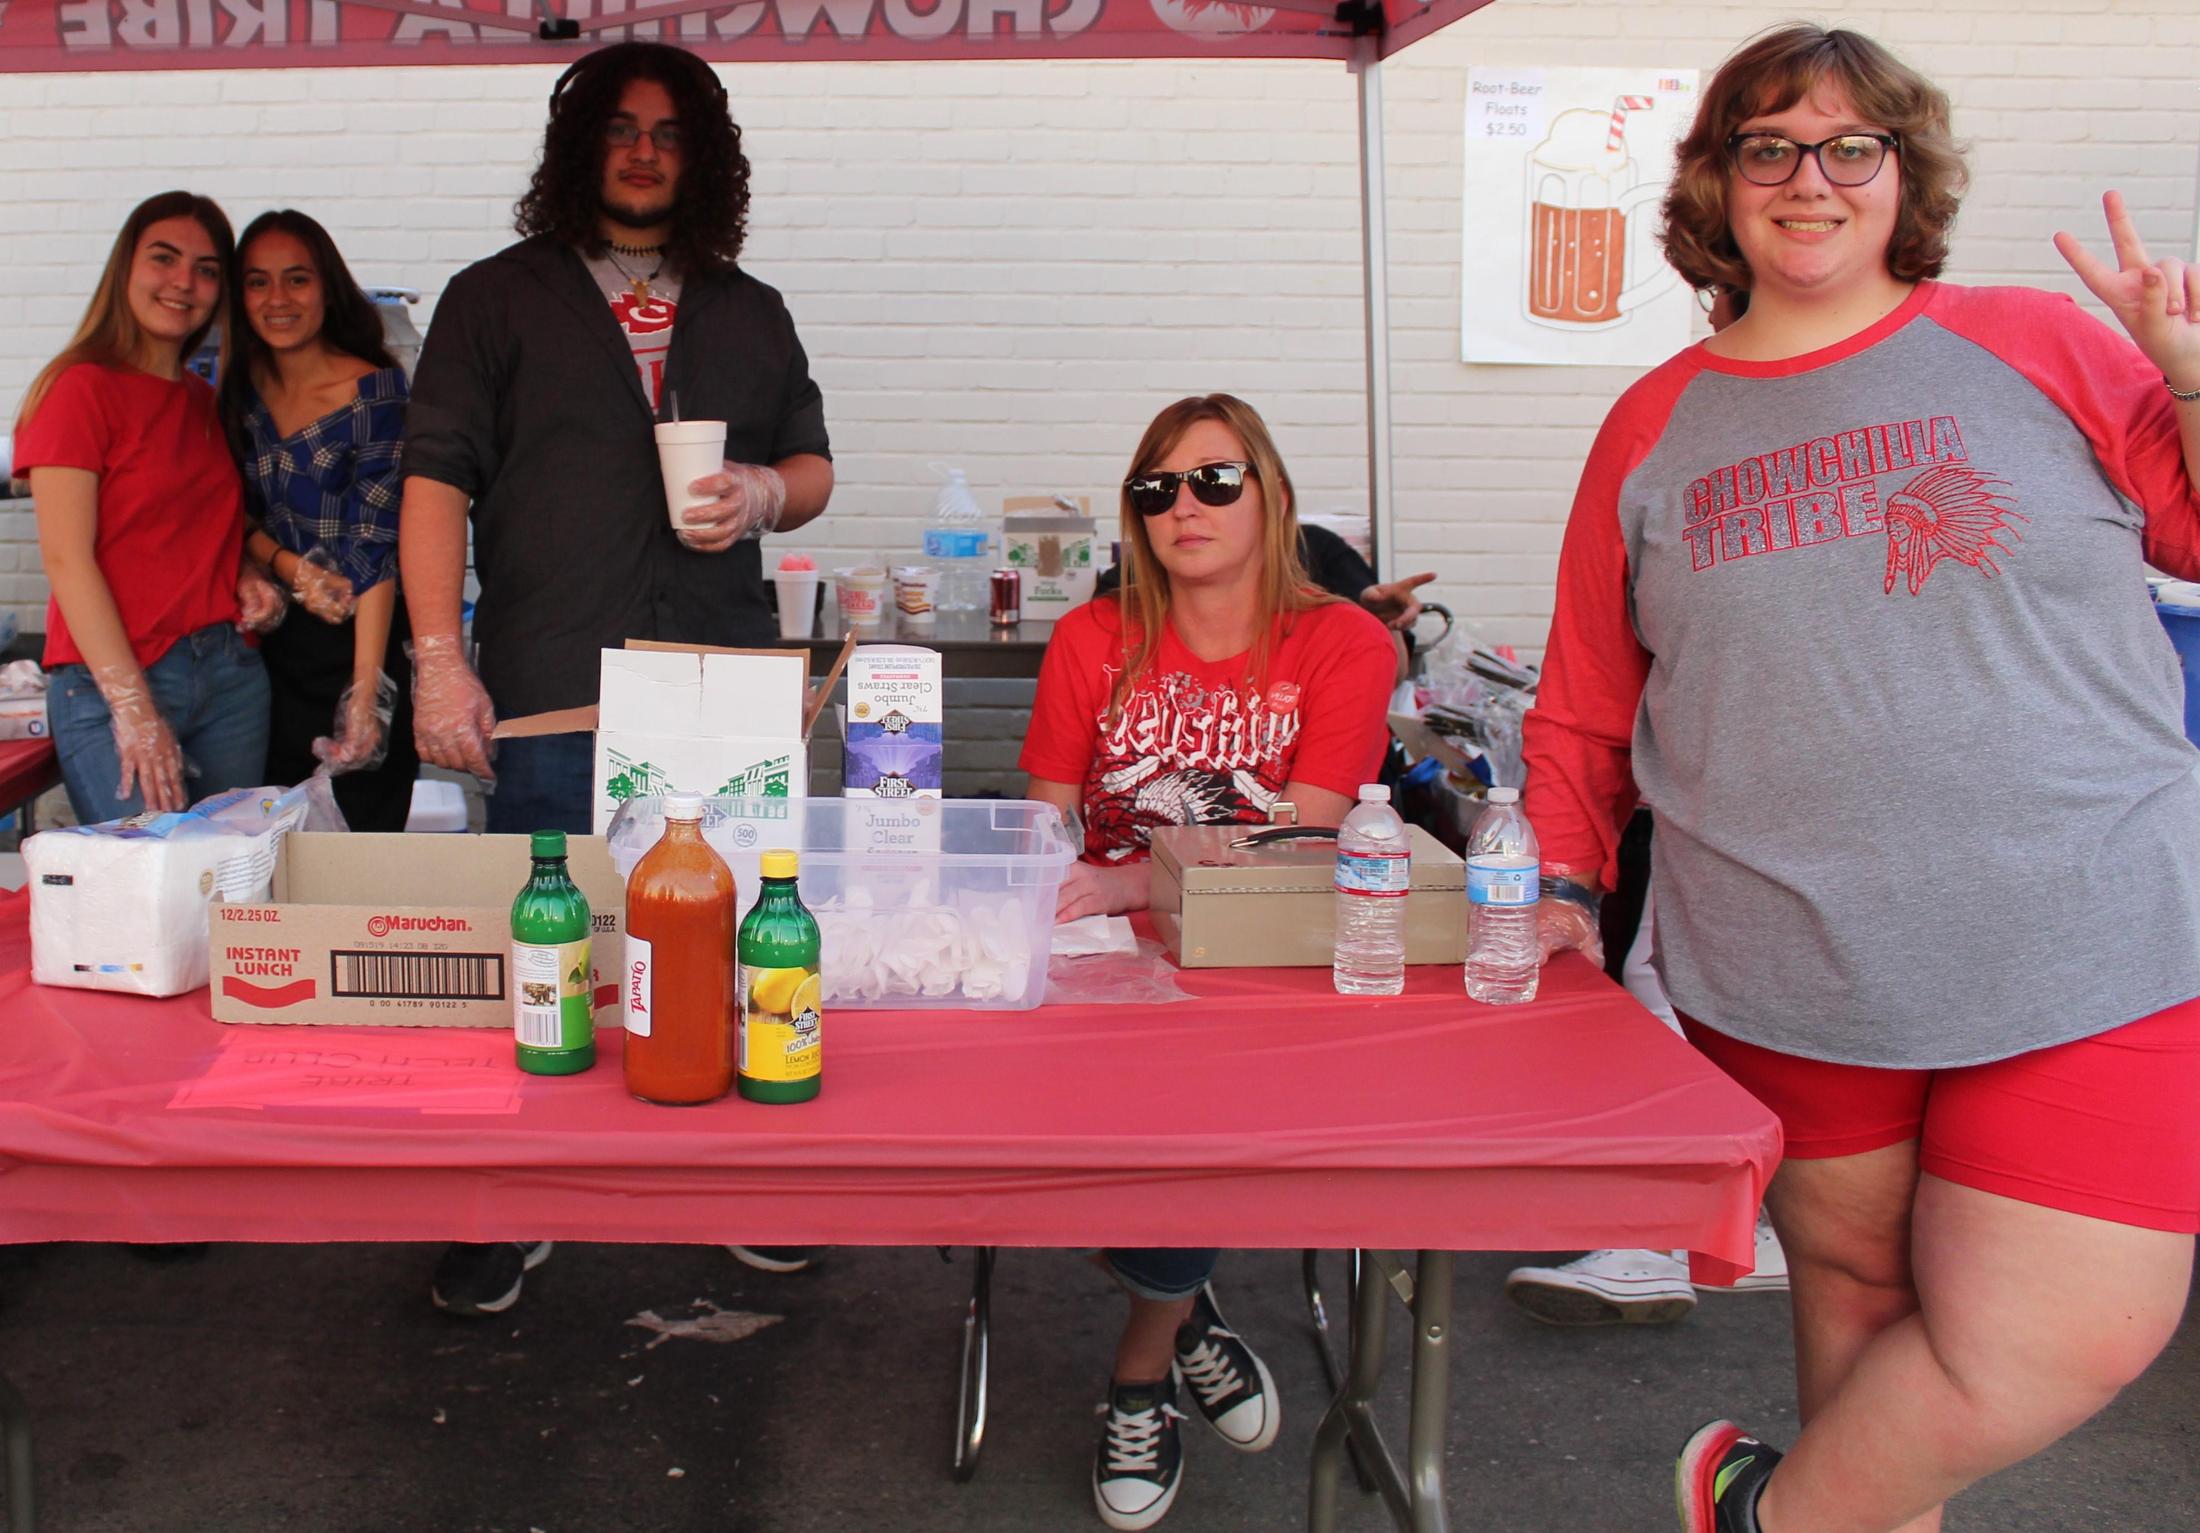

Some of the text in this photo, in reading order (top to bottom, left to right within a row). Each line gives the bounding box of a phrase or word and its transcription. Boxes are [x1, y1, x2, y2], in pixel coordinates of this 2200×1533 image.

[1472, 80, 1543, 96] Root-Beer
[1485, 101, 1529, 116] Floats
[1486, 122, 1527, 136] $2.50
[1683, 415, 1968, 525] CHOWCHILLA
[1683, 480, 1884, 573] TRIBE
[857, 682, 933, 693] Clear Straws
[874, 694, 916, 706] Jumbo
[880, 776, 909, 788] FIRST
[875, 787, 912, 798] STREET
[865, 814, 921, 827] Jumbo
[736, 828, 756, 839] 500
[872, 830, 915, 844] Clear
[220, 909, 281, 922] 12/2.25 OZ.
[387, 915, 467, 932] Maruchan
[226, 946, 301, 962] INSTANT
[235, 962, 293, 977] LUNCH
[430, 1001, 457, 1009] 90122
